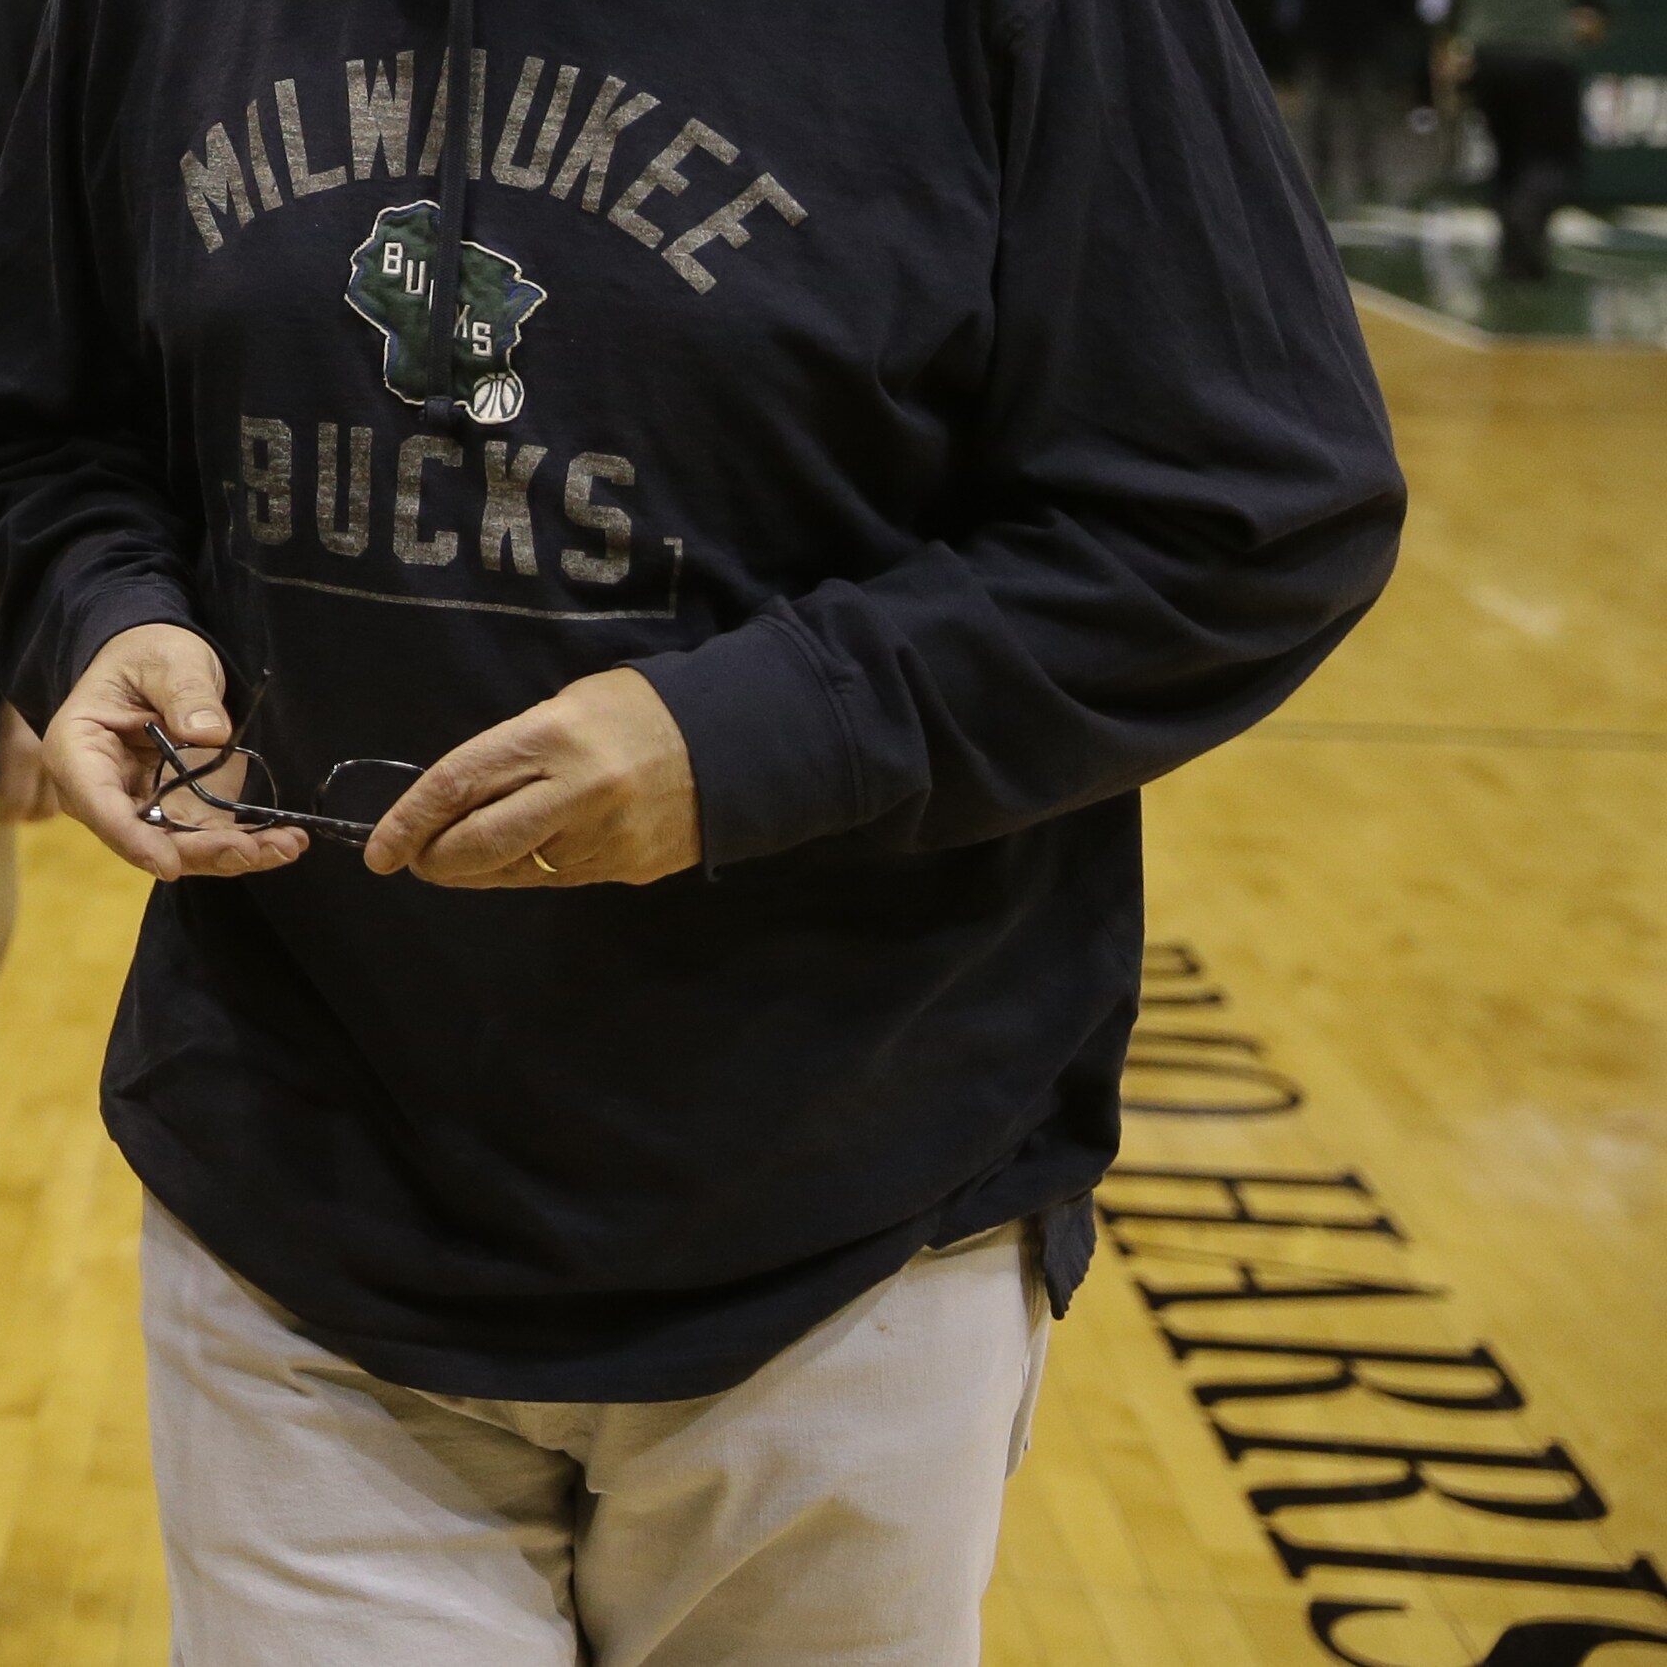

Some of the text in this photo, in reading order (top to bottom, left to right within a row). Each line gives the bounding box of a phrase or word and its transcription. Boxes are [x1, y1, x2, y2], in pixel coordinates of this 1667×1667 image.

[178, 47, 809, 295] MILWAUKEE
[381, 241, 494, 358] BUKS
[239, 415, 636, 586] BUCKS
